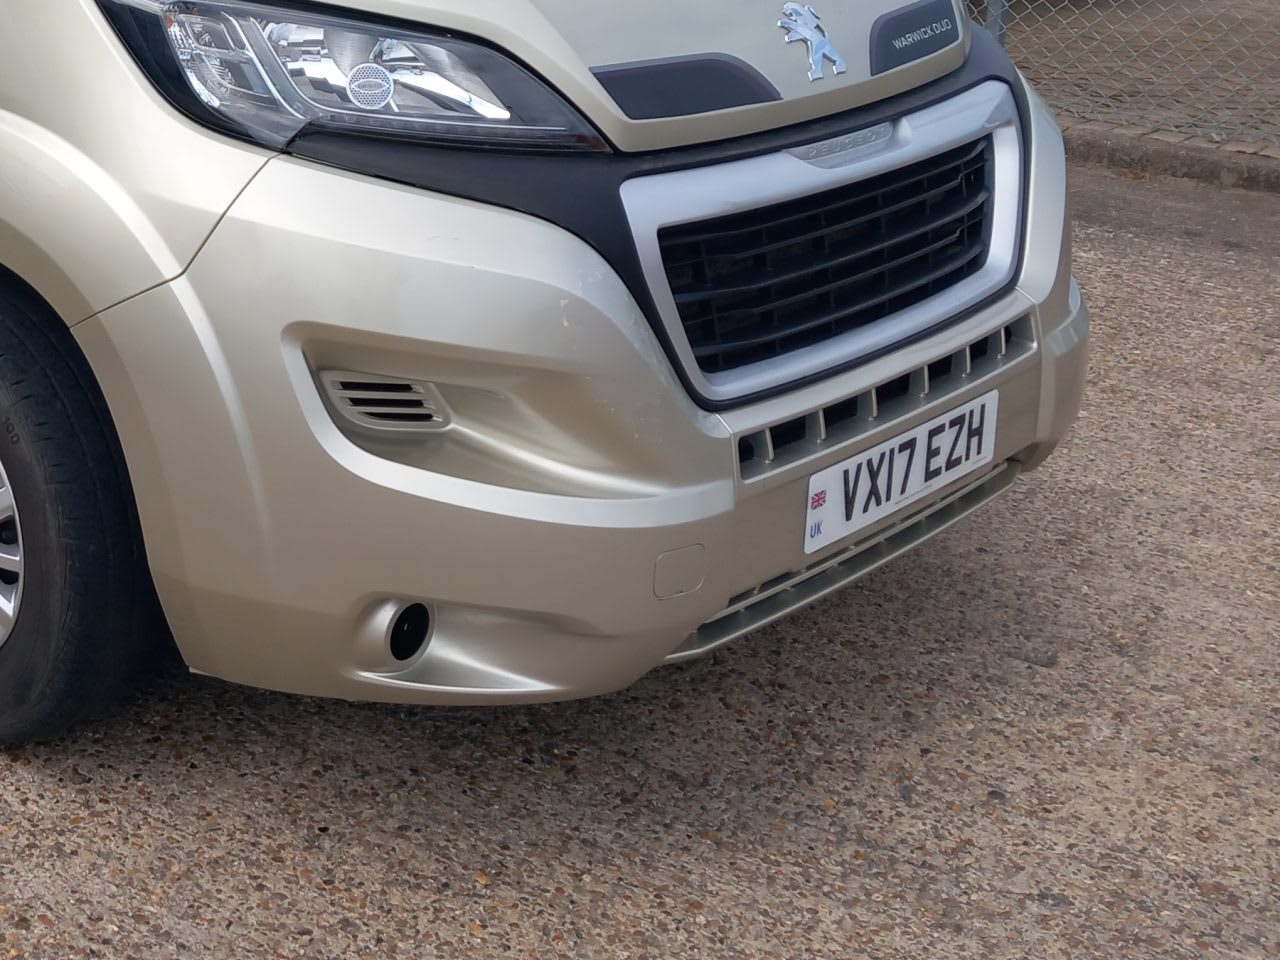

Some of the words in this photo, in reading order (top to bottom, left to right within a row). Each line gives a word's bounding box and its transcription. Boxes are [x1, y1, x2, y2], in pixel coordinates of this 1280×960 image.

[892, 25, 934, 50] WARWICK
[932, 18, 952, 34] DUO
[842, 436, 918, 522] VX17
[924, 402, 986, 483] EZH
[809, 520, 823, 538] UK
